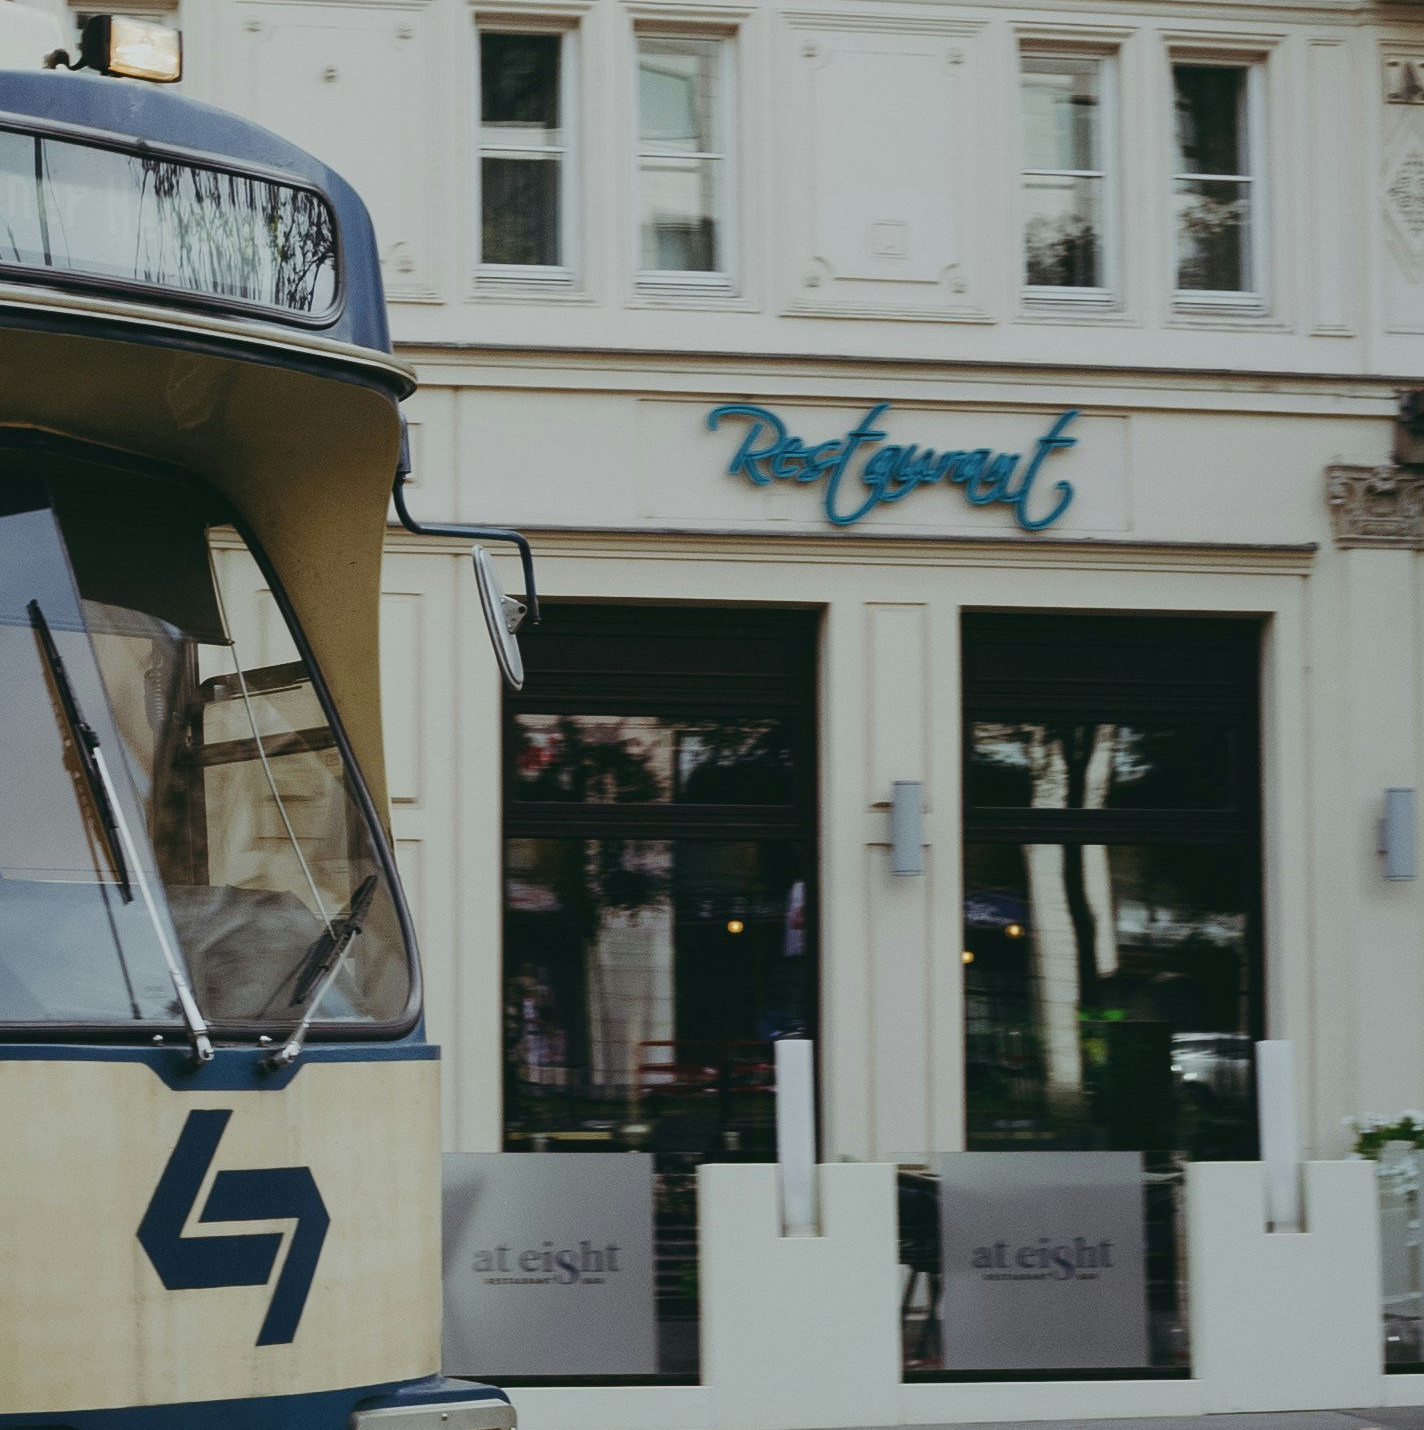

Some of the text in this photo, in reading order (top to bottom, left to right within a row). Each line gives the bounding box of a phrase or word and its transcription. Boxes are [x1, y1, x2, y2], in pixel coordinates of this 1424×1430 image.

[706, 402, 1081, 531] Restaurant
[473, 1240, 623, 1285] at eight
[971, 1237, 1114, 1281] at eight
